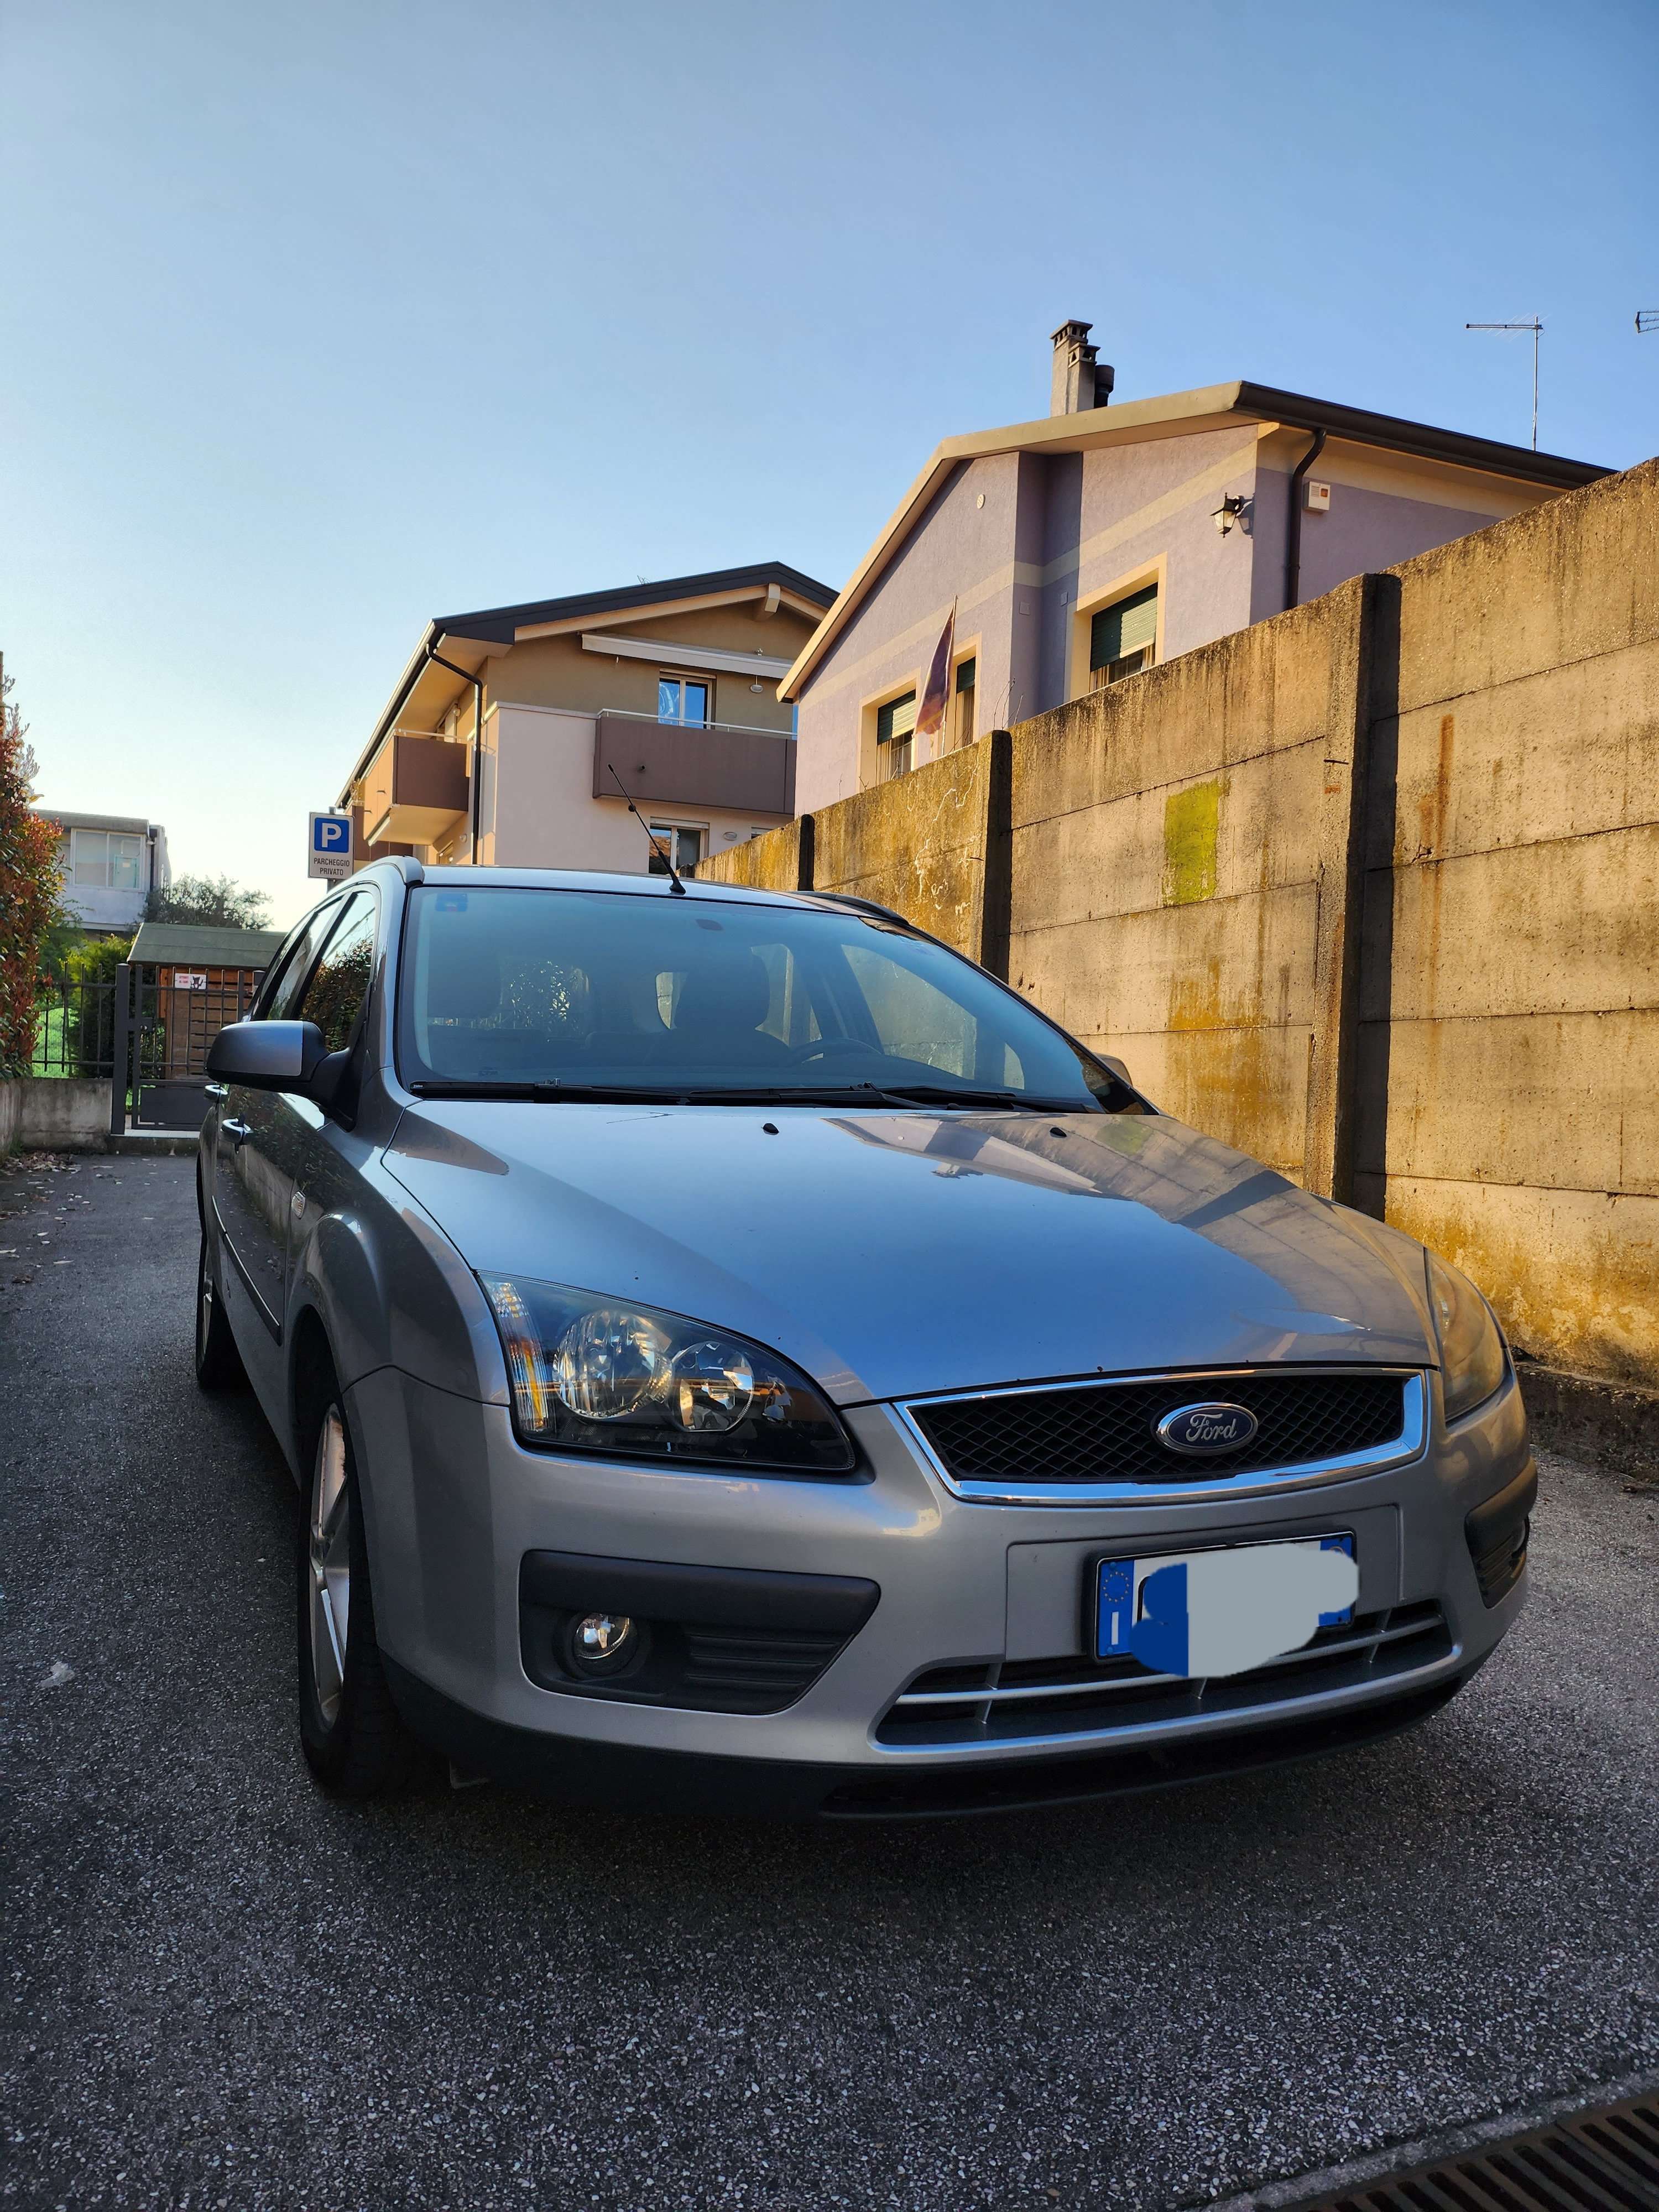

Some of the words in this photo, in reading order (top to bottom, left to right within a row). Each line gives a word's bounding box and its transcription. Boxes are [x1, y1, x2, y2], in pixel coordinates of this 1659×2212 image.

[322, 822, 342, 848] P
[314, 858, 350, 867] PARCHEGGIO
[1186, 1413, 1237, 1442] Ford
[1111, 1611, 1119, 1646] I
